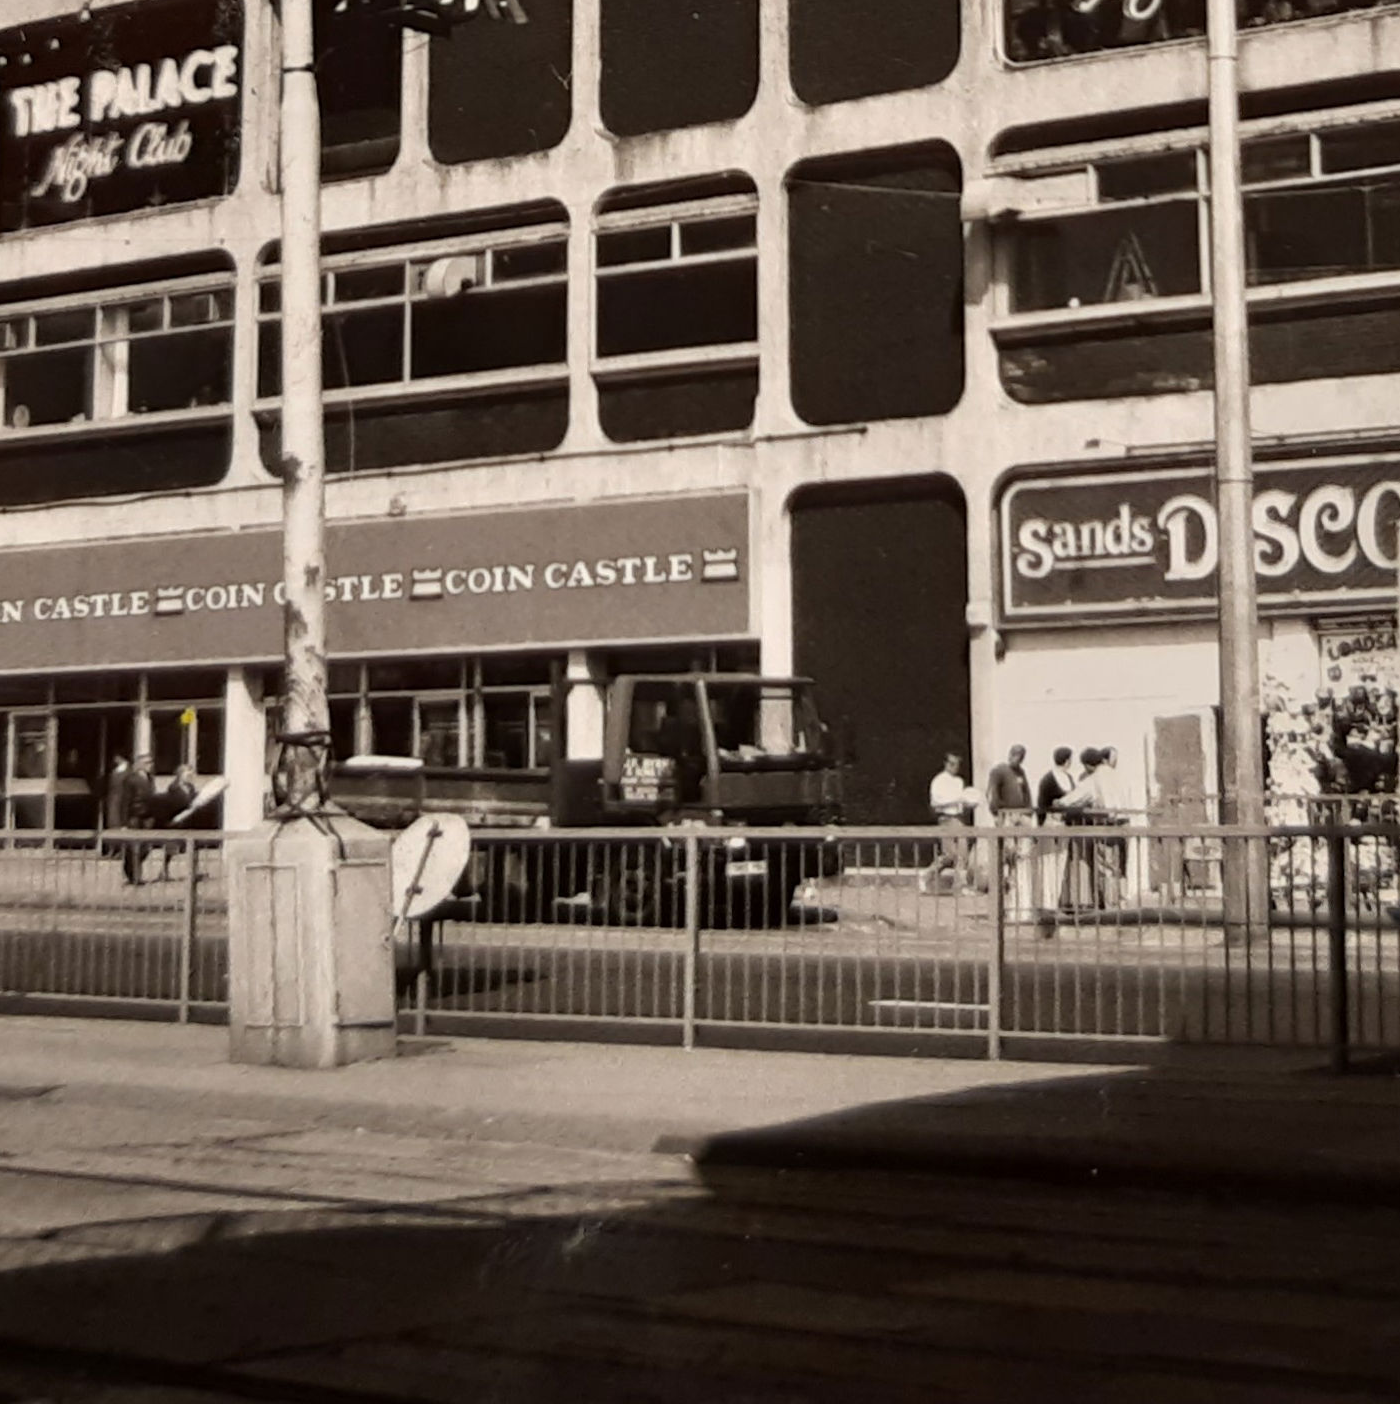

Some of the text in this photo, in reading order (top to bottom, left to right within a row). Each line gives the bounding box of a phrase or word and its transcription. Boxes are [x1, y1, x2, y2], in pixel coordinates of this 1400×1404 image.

[10, 46, 240, 137] THE PALACE
[31, 118, 193, 203] Night Club
[1014, 503, 1154, 581] Sands
[34, 591, 150, 620] CASTLE
[186, 583, 266, 610] COIN
[274, 573, 403, 605] CSTLE
[445, 565, 533, 594] COIN
[544, 554, 694, 589] CASTLE
